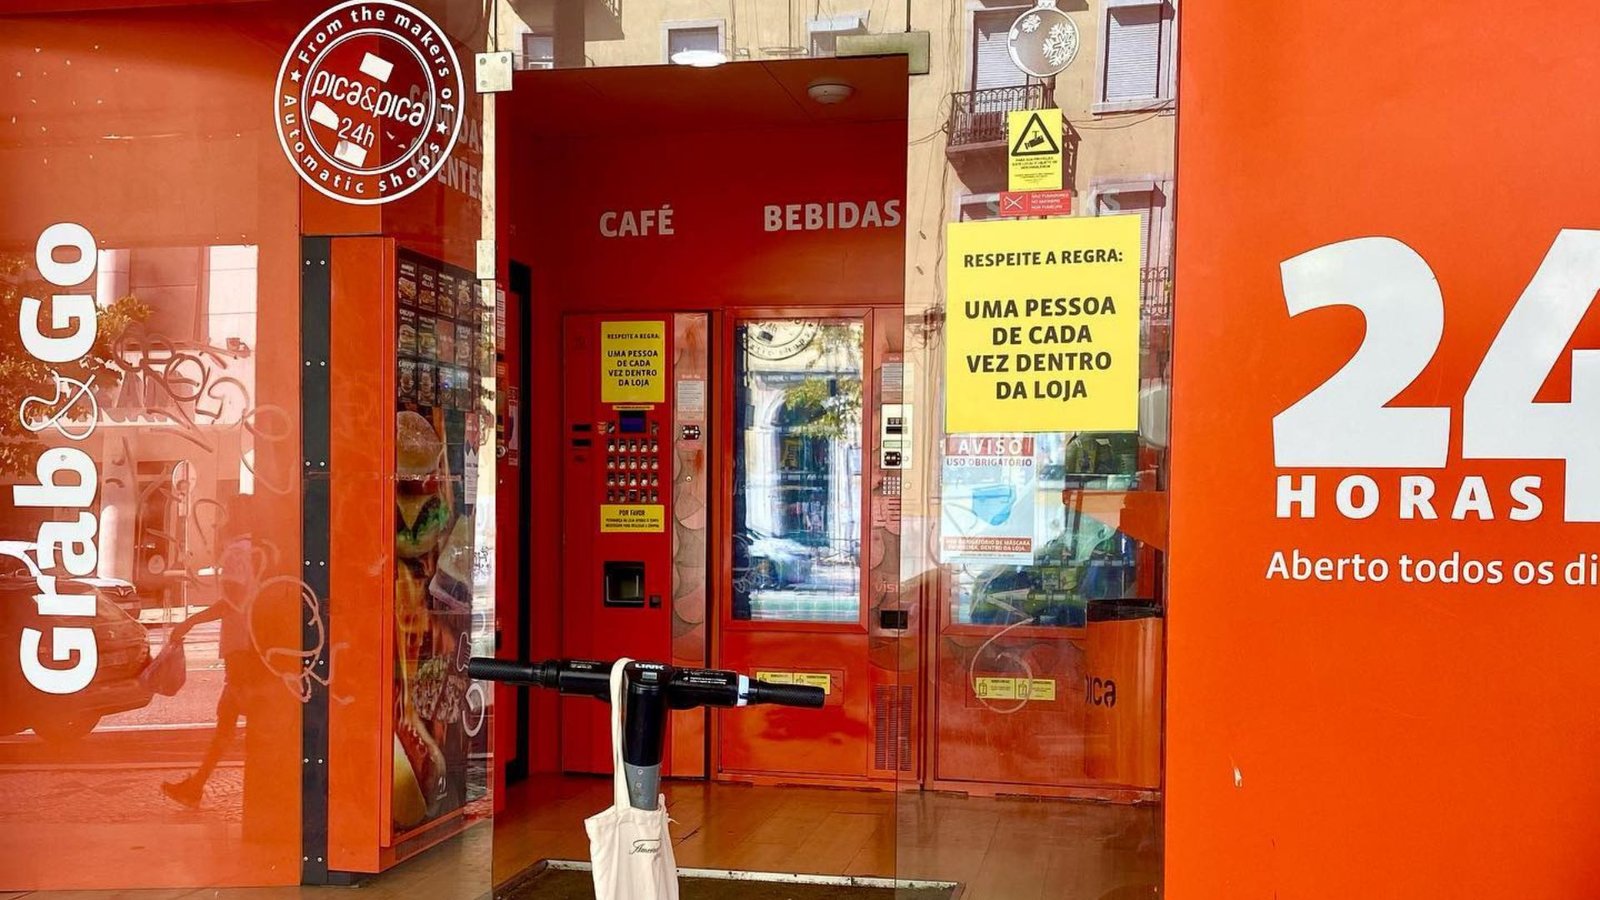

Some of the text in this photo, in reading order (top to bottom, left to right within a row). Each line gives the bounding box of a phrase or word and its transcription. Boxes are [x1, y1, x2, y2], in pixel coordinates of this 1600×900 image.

[298, 6, 454, 112] From the makers of
[311, 70, 426, 127] pica&pica
[284, 95, 440, 193] Automatic shops
[338, 117, 375, 149] 24h
[600, 204, 674, 237] CAFÉ
[764, 200, 901, 232] BEBIDAS
[964, 249, 1123, 268] RESPEITE A REGRA:
[19, 222, 98, 363] Go
[965, 296, 1116, 319] UMA PESSOA
[992, 325, 1092, 346] DE CADA
[607, 350, 626, 358] UMA
[967, 351, 1112, 373] VEZ DENTRO
[618, 379, 650, 387] DA LOJA
[625, 369, 657, 377] DENTRO
[1272, 228, 1600, 523] 24
[996, 380, 1088, 402] DA LOJA
[946, 458, 966, 467] USO
[1276, 474, 1543, 521] HORAS
[13, 447, 98, 694] Grab
[1266, 549, 1389, 582] Aberto
[1399, 552, 1503, 583] todos
[1513, 559, 1554, 584] os
[635, 663, 665, 671] LINK
